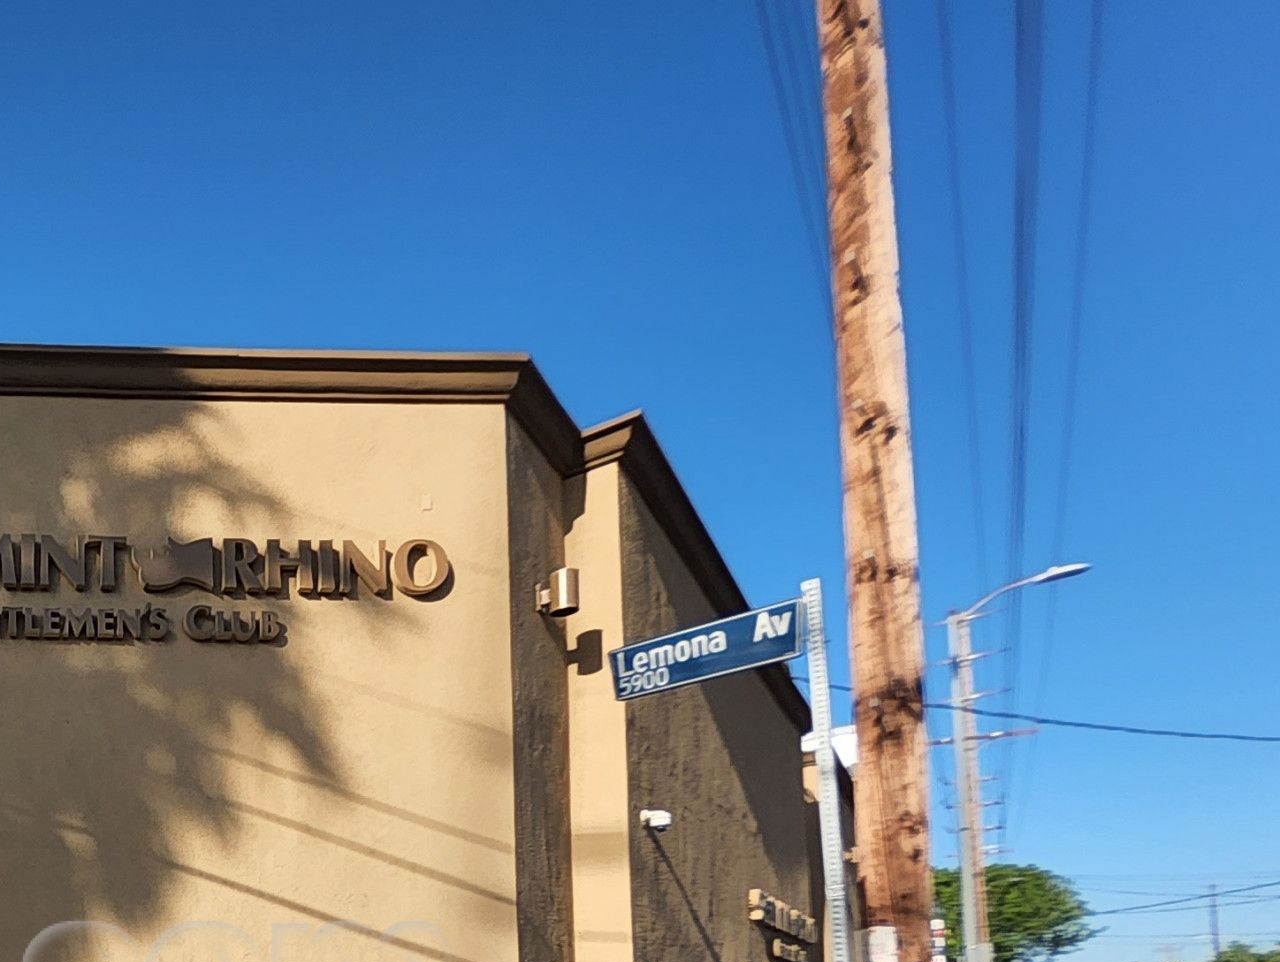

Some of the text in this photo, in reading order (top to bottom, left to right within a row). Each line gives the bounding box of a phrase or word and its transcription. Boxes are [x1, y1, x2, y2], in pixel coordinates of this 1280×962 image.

[222, 537, 455, 598] RHINO
[183, 604, 286, 644] CLUB
[617, 612, 792, 678] Lemona Av
[619, 668, 670, 696] 5900
